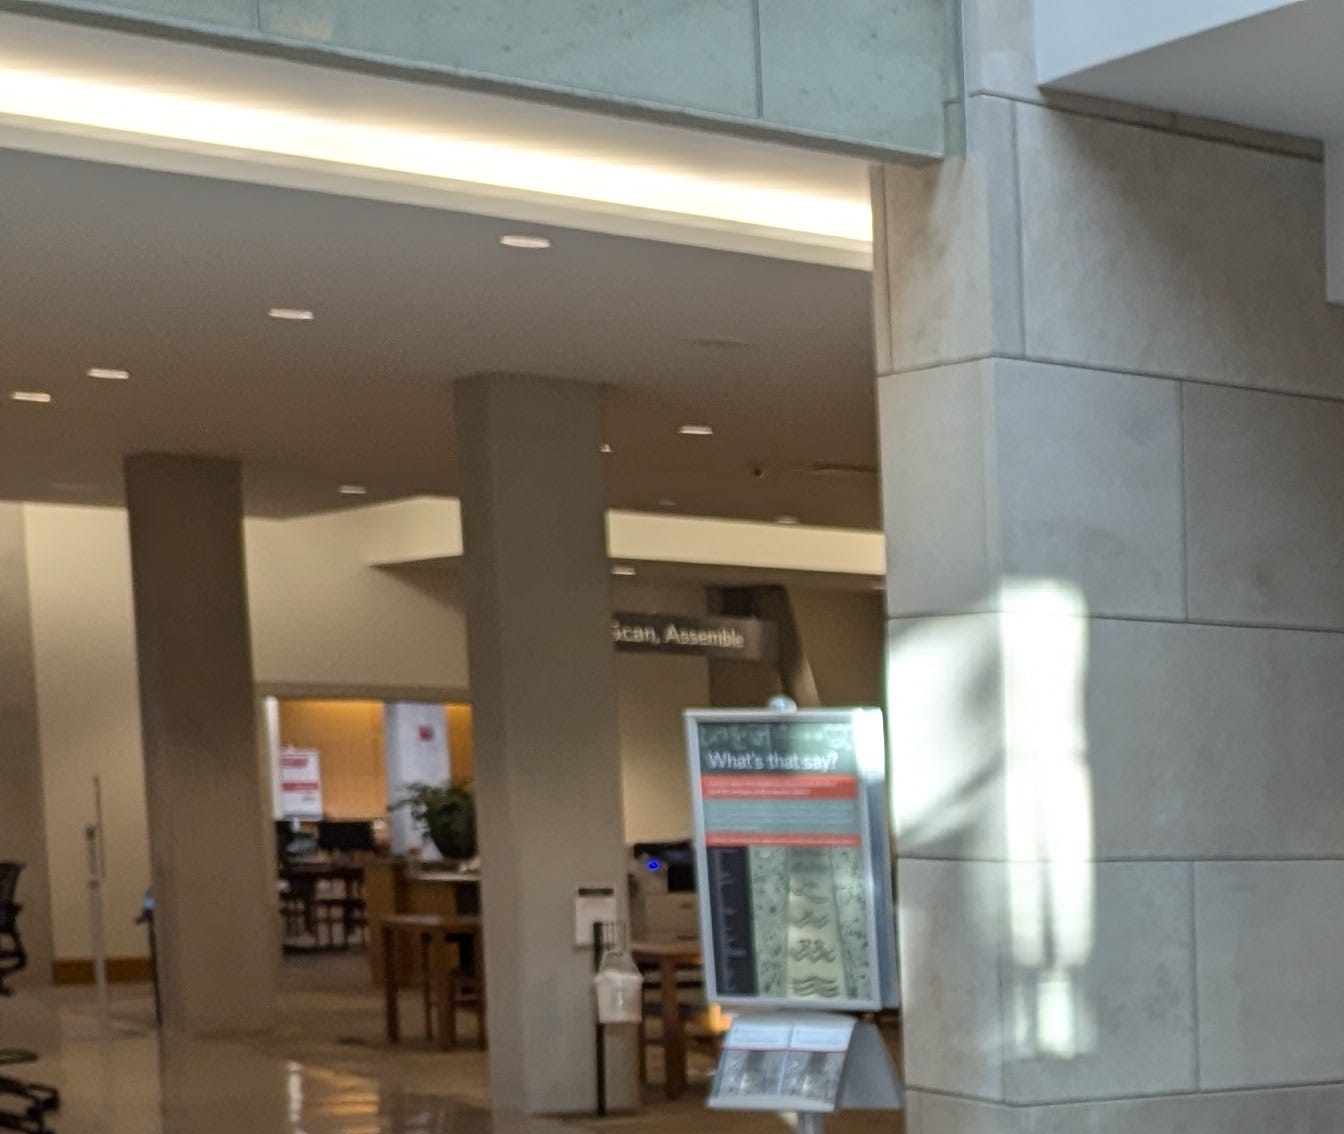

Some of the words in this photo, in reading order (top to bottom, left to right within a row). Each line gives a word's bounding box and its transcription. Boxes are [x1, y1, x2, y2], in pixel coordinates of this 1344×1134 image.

[665, 623, 745, 648] Assemble
[707, 752, 764, 770] What's
[768, 752, 800, 770] that
[803, 751, 839, 773] say?
